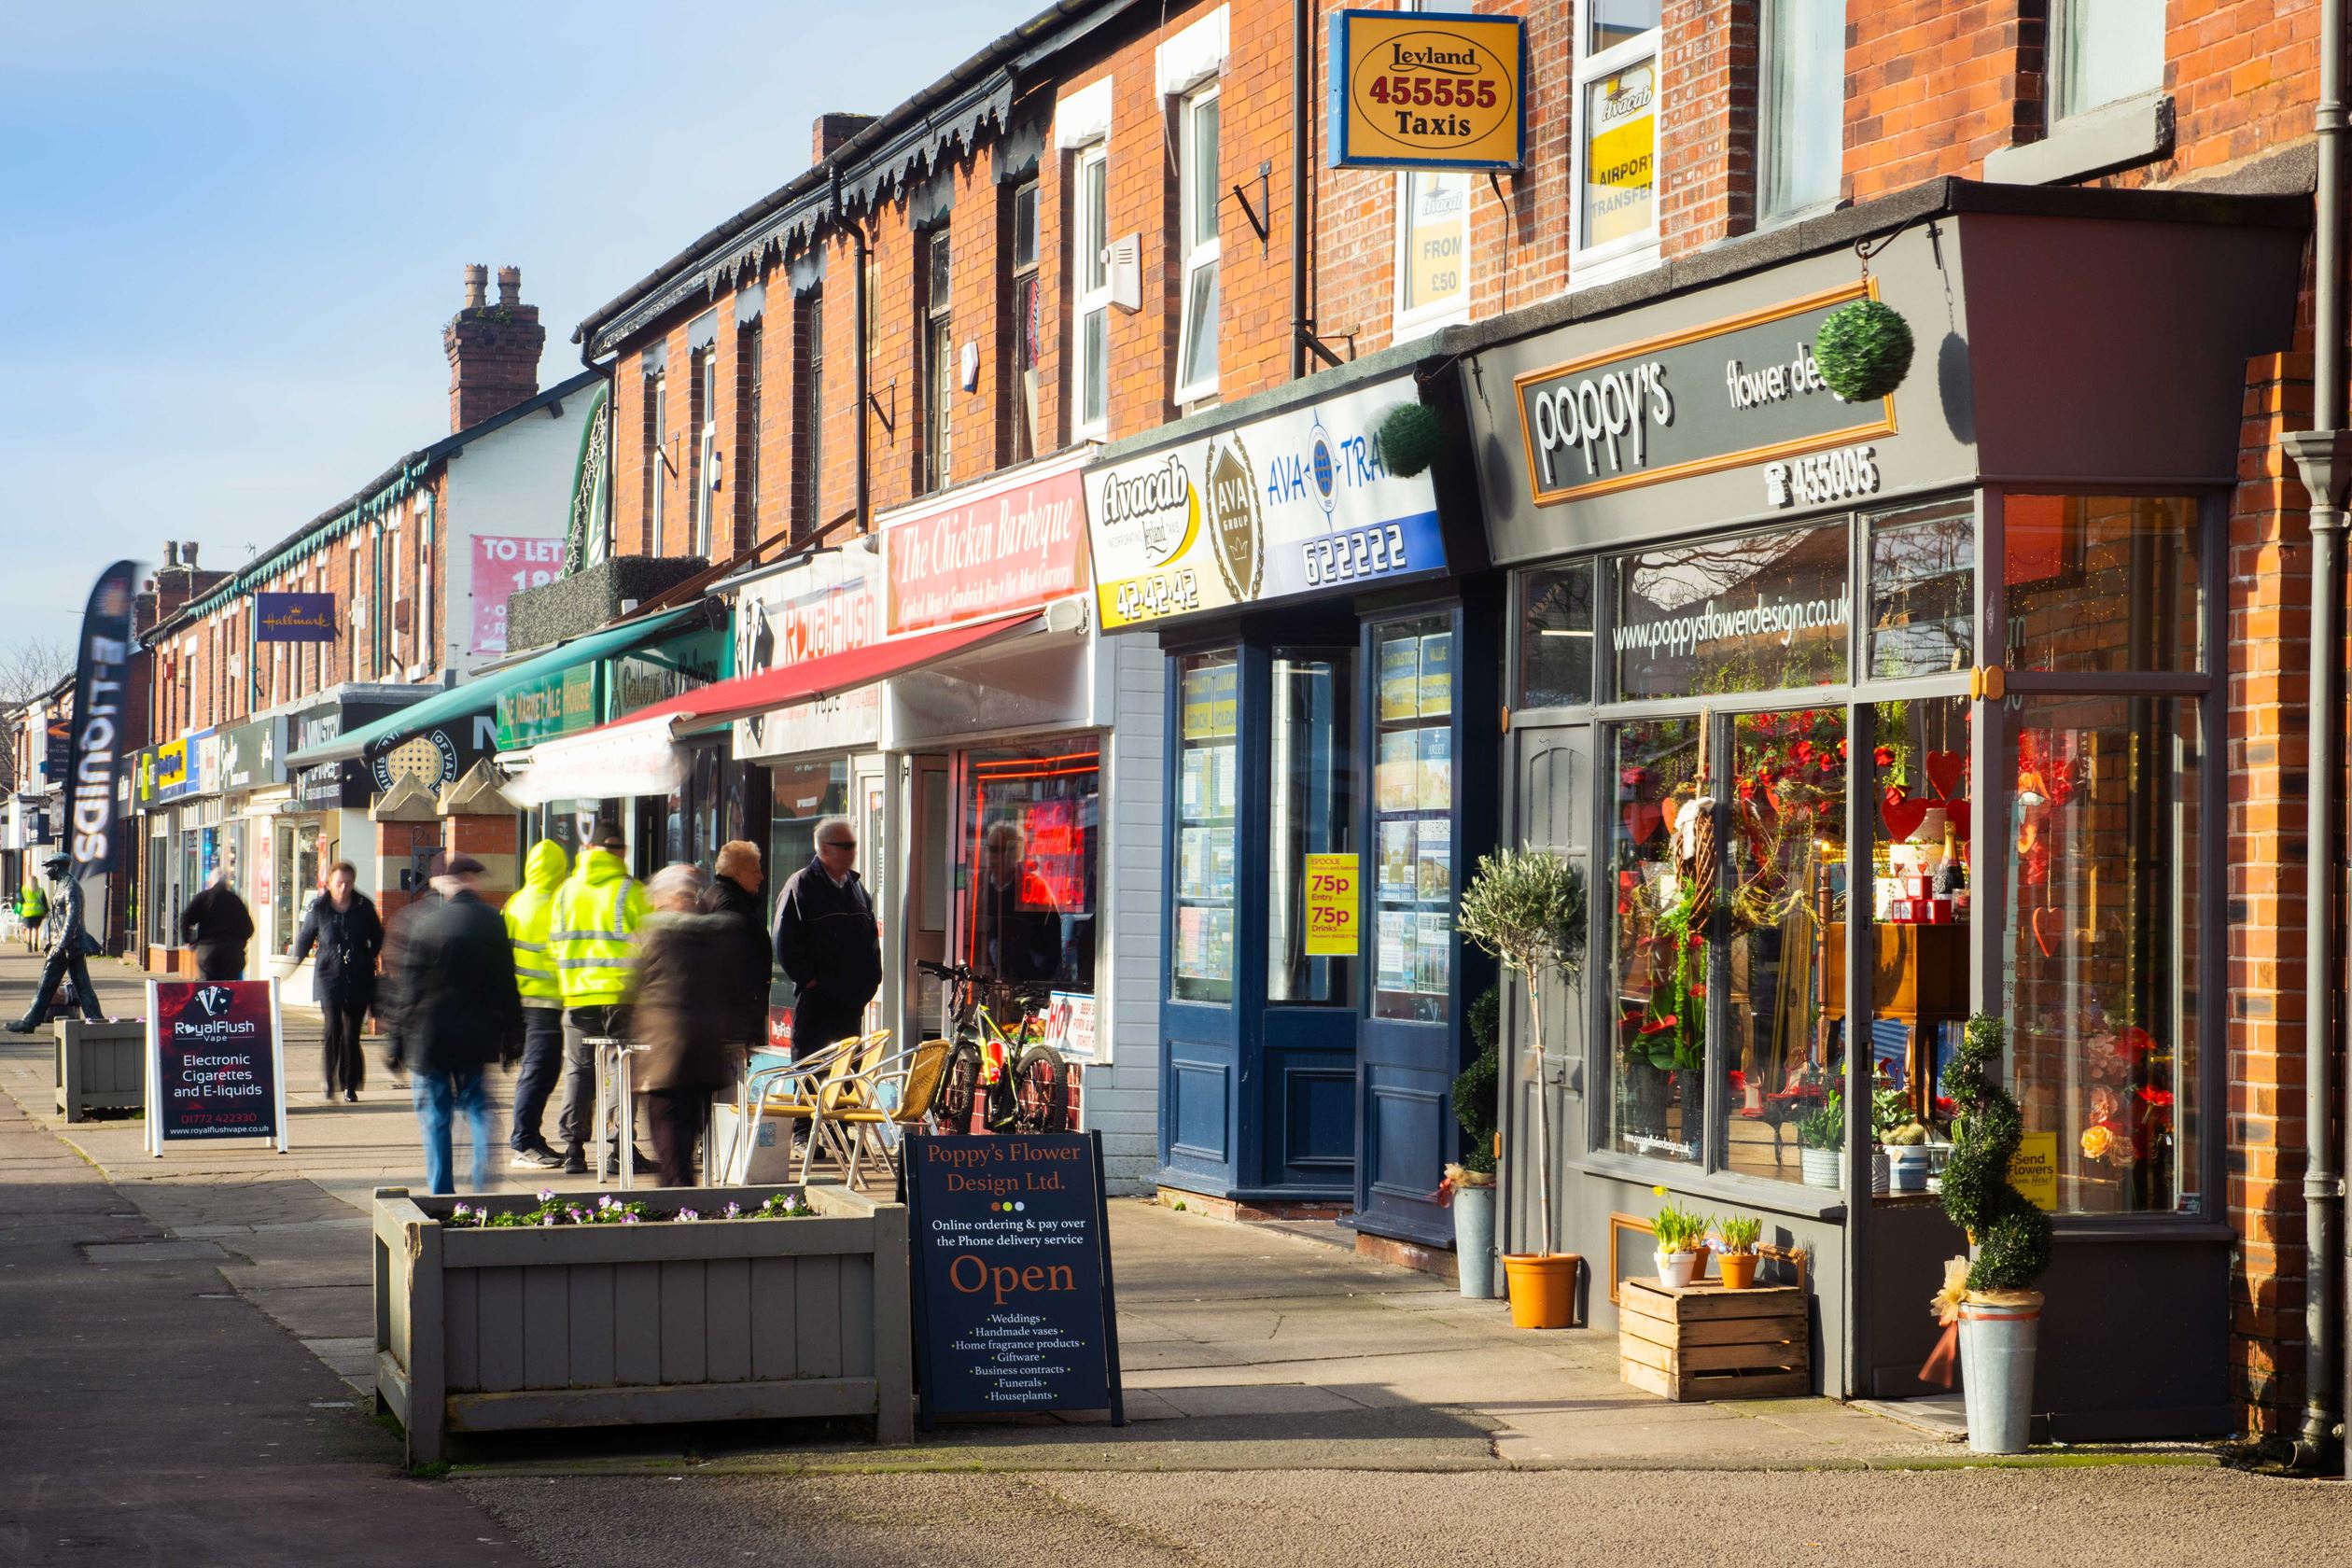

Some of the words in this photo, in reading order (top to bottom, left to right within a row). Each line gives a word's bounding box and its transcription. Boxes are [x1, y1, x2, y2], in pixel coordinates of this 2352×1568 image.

[1389, 43, 1482, 75] Leyland
[1369, 76, 1496, 108] 455555
[1601, 85, 1653, 122] Avacab
[1394, 110, 1471, 136] Taxis
[1600, 153, 1654, 187] AIRPORT
[1423, 235, 1462, 259] FROM
[1432, 271, 1456, 291] £50
[1534, 360, 1672, 484] poppy's
[1727, 358, 1788, 409] flower
[1267, 454, 1307, 507] AVA
[1340, 431, 1387, 488] TRA
[1793, 446, 1873, 502] 455005
[1102, 454, 1189, 526] Avacab
[1218, 478, 1249, 514] AVA
[1223, 514, 1249, 532] GROUP
[902, 525, 929, 583] The
[932, 508, 993, 576] Chicken
[996, 491, 1073, 560] Barbeque
[483, 539, 518, 560] TO
[525, 540, 564, 562] LET
[1302, 523, 1407, 586] 622222
[901, 595, 925, 622] Cooked
[949, 580, 984, 609] Sandwich
[986, 578, 1000, 604] Bar
[1038, 563, 1071, 592] Carvery
[261, 612, 330, 632] Hallmark
[1613, 582, 1849, 659] www.poppysflowerdesign.co.uk
[545, 686, 560, 718] ALE
[563, 680, 591, 715] HOUSE
[435, 735, 449, 749] OF
[1311, 875, 1350, 894] 75p
[1311, 907, 1350, 926] 75p
[1047, 1002, 1073, 1041] HOT
[203, 1034, 228, 1043] Vape
[183, 1054, 250, 1067] Electronic
[182, 1070, 253, 1084] Cigarettes
[174, 1085, 200, 1098] and
[203, 1084, 262, 1098] E-liquids
[181, 1114, 213, 1125] 01772
[215, 1113, 258, 1124] 422330
[170, 1125, 270, 1135] www.royalflushvape.co.uk
[927, 1143, 1004, 1167] Poppy's
[1009, 1142, 1081, 1160] Flower
[2015, 1153, 2046, 1165] Send
[2008, 1165, 2054, 1176] Flowers
[2031, 1174, 2053, 1185] Here!
[946, 1173, 1019, 1196] Design
[1026, 1172, 1066, 1191] Ltd.
[931, 1220, 973, 1231] Online
[974, 1219, 1024, 1234] ordering
[1026, 1219, 1036, 1229] &
[1038, 1221, 1058, 1232] pay
[1060, 1219, 1085, 1229] over
[936, 1236, 956, 1247] the
[958, 1235, 994, 1246] Phone
[996, 1234, 1043, 1248] delivery
[1043, 1235, 1084, 1245] service
[950, 1254, 1077, 1305] Open
[991, 1313, 1041, 1325] Weddings
[975, 1326, 1030, 1337] Handmade
[956, 1340, 987, 1350] Home
[988, 1339, 1035, 1352] fragrance
[1036, 1338, 1080, 1351] products
[997, 1351, 1041, 1362] Giftware
[974, 1365, 1018, 1375] Business
[1019, 1365, 1065, 1375] contracts
[999, 1378, 1043, 1388] Funerals
[990, 1391, 1053, 1403] Houseplants
